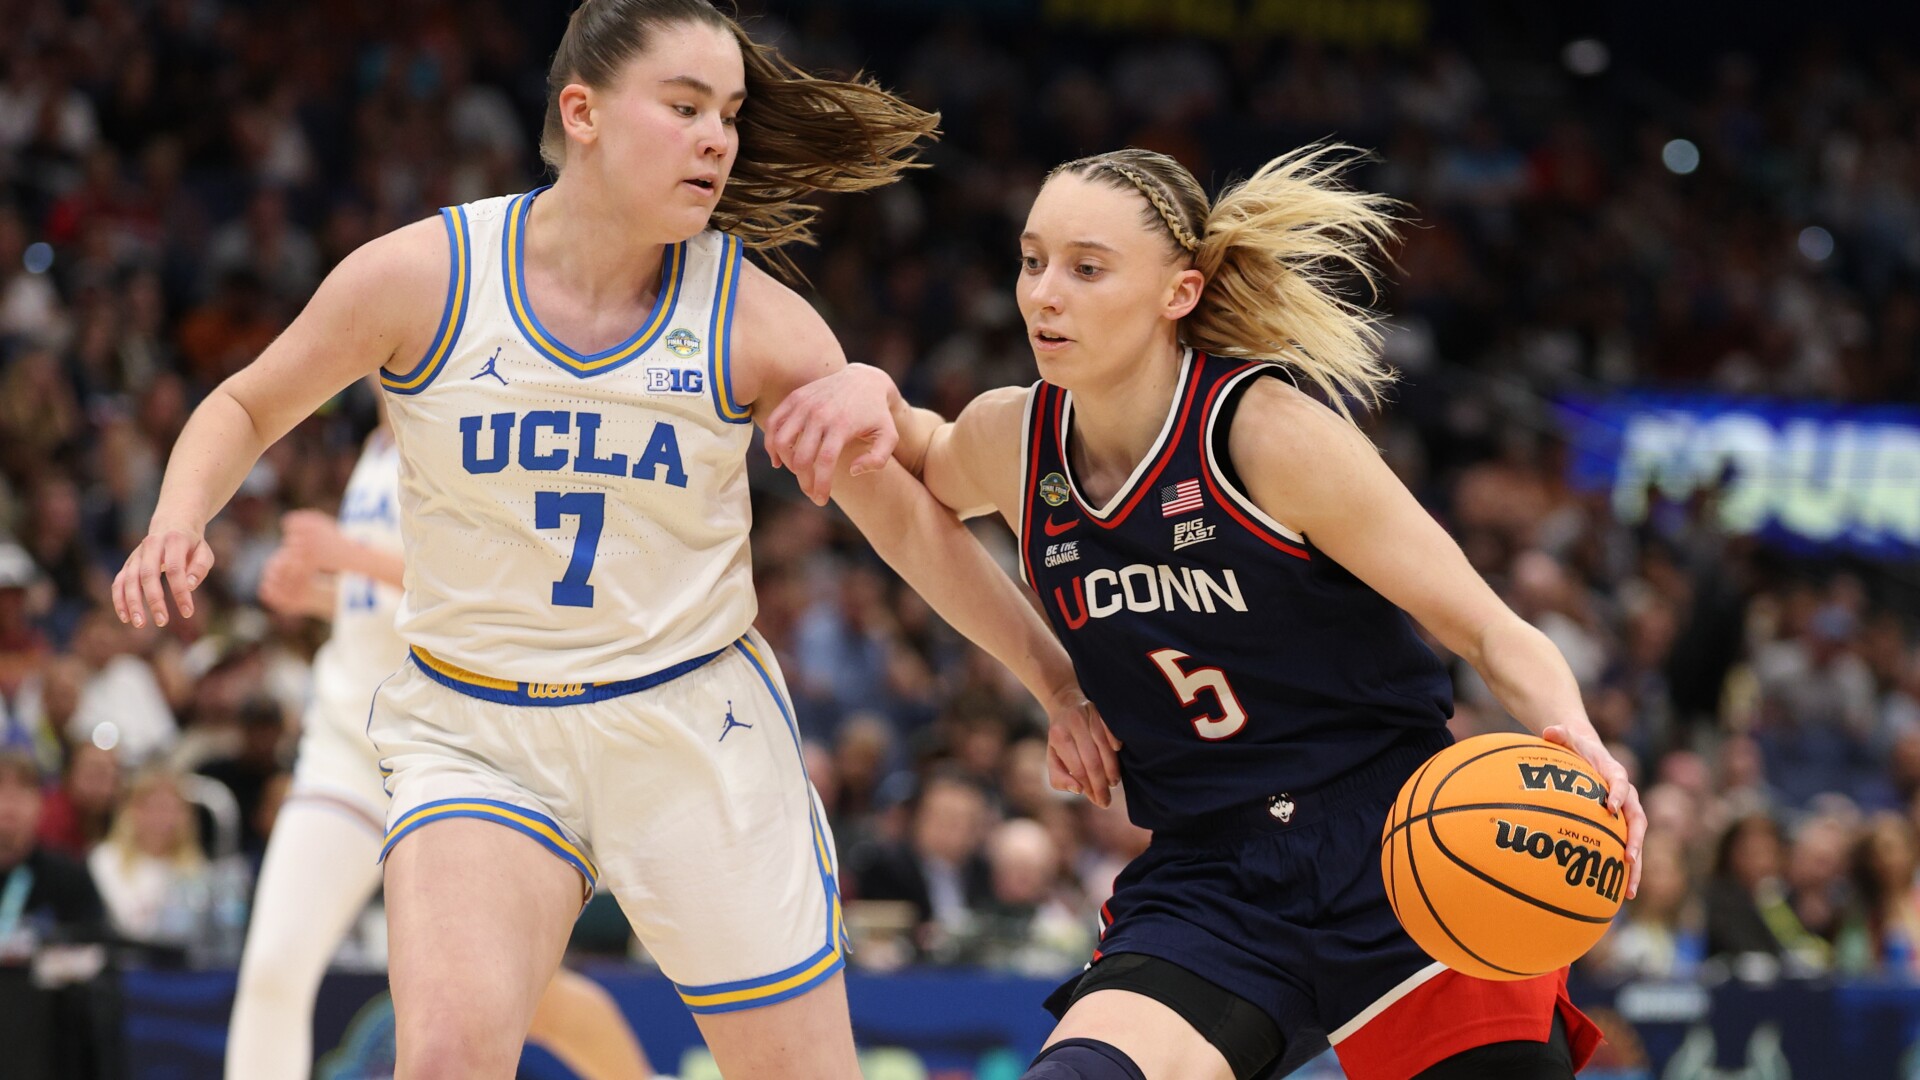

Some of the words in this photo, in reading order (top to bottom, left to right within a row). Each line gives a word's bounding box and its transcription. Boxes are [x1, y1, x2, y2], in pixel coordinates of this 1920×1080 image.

[459, 410, 689, 488] UCLA
[1174, 518, 1204, 535] BIG
[1174, 525, 1217, 545] EAST
[535, 491, 605, 608] 7
[1044, 549, 1081, 568] CHANGE
[1046, 544, 1060, 557] BE
[1060, 541, 1080, 553] THE
[1054, 563, 1249, 630] UCONN
[1145, 648, 1249, 742] 5
[1557, 827, 1580, 840] NXT
[1582, 835, 1601, 848] EVO
[1495, 818, 1625, 904] Wilson
